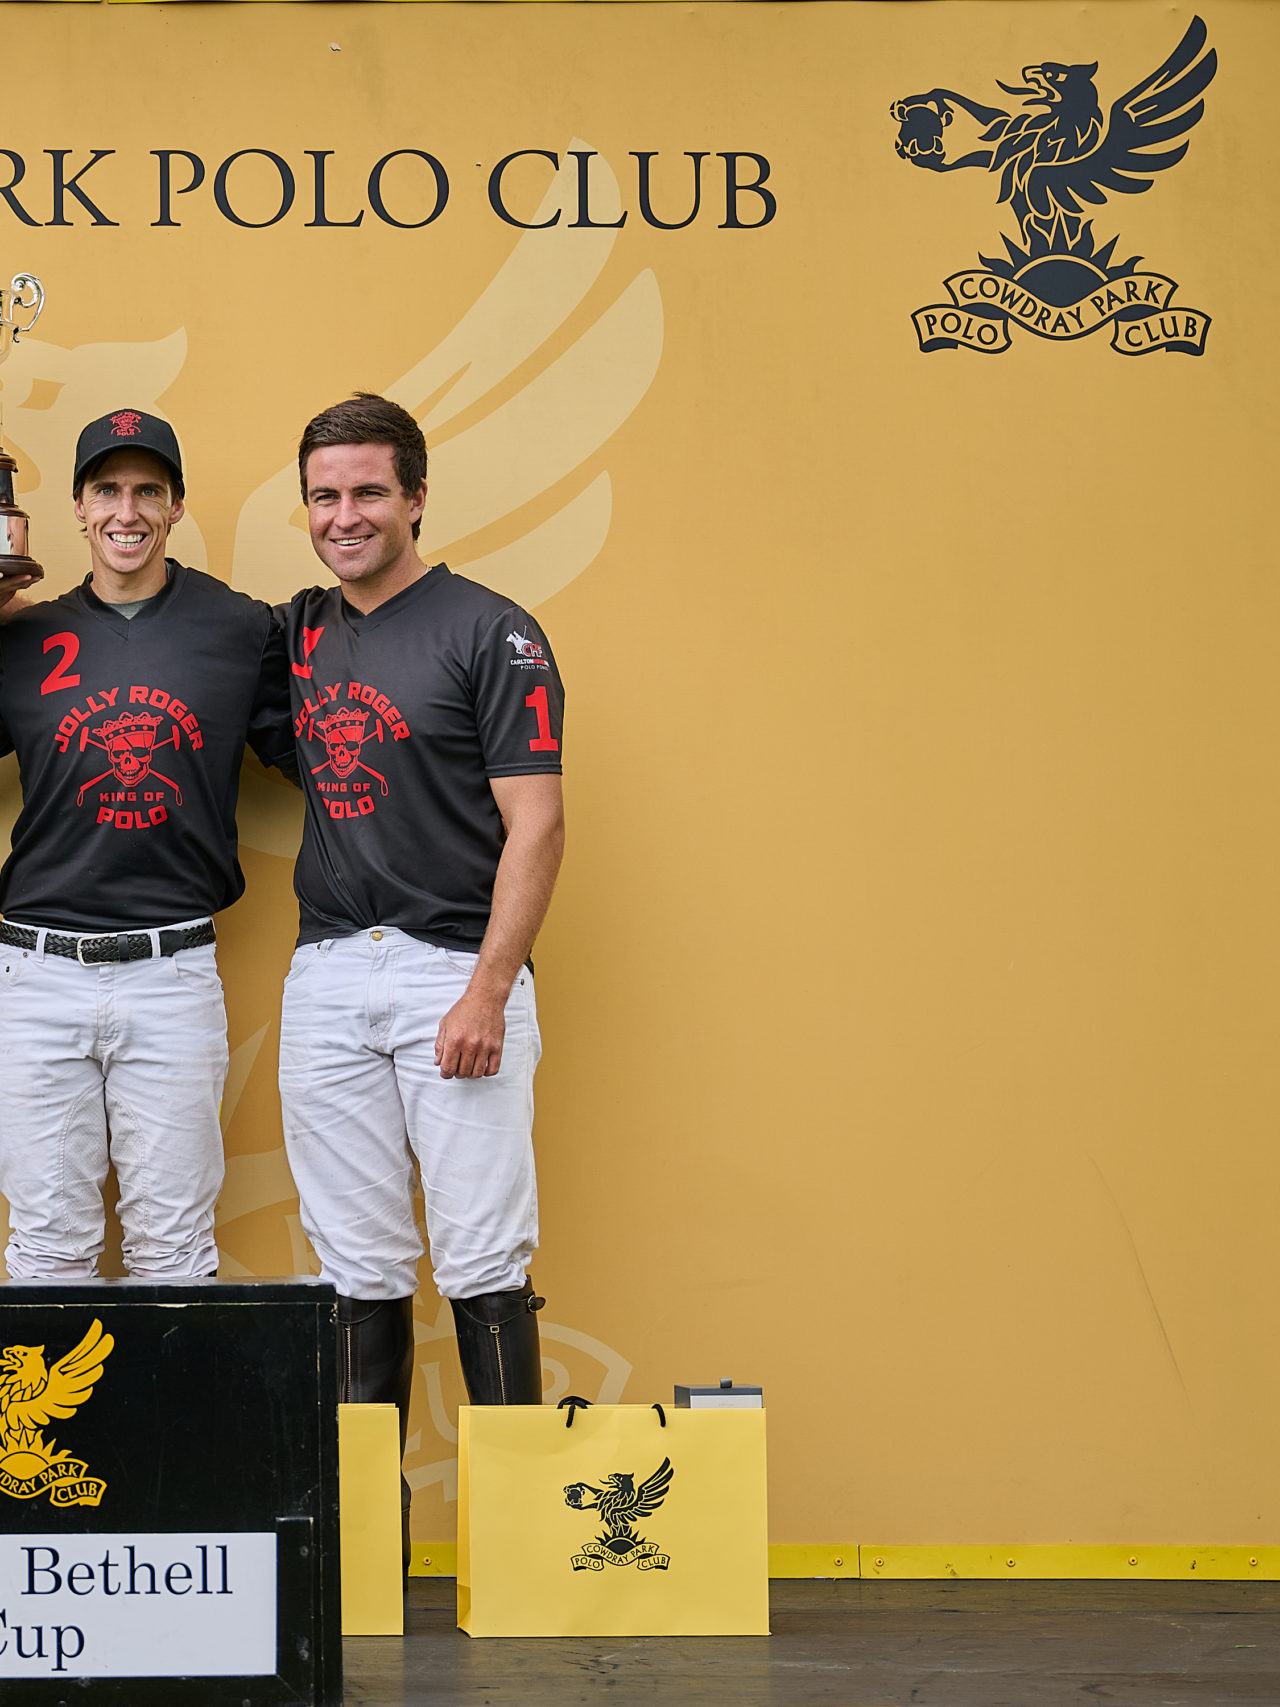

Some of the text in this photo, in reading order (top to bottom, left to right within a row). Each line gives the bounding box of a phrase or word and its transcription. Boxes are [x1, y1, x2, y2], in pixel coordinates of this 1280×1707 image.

[149, 148, 449, 229] POLO
[488, 148, 777, 230] CLUB
[959, 277, 1164, 333] COWDRAY PARK
[923, 313, 1198, 347] POLO CLUB
[40, 631, 81, 696] 2
[54, 685, 204, 753] JOLLY ROGER
[294, 681, 411, 742] JOLLY ROGER
[525, 685, 559, 752] 1
[99, 791, 165, 802] KING OF
[316, 782, 371, 793] KING OF
[96, 804, 168, 830] POLO
[38, 1463, 80, 1486] PARK
[56, 1482, 99, 1502] CLUB
[19, 1544, 234, 1596] Bethell
[574, 1556, 666, 1569] POLO CLUB
[586, 1544, 656, 1565] COWDRAY PARK
